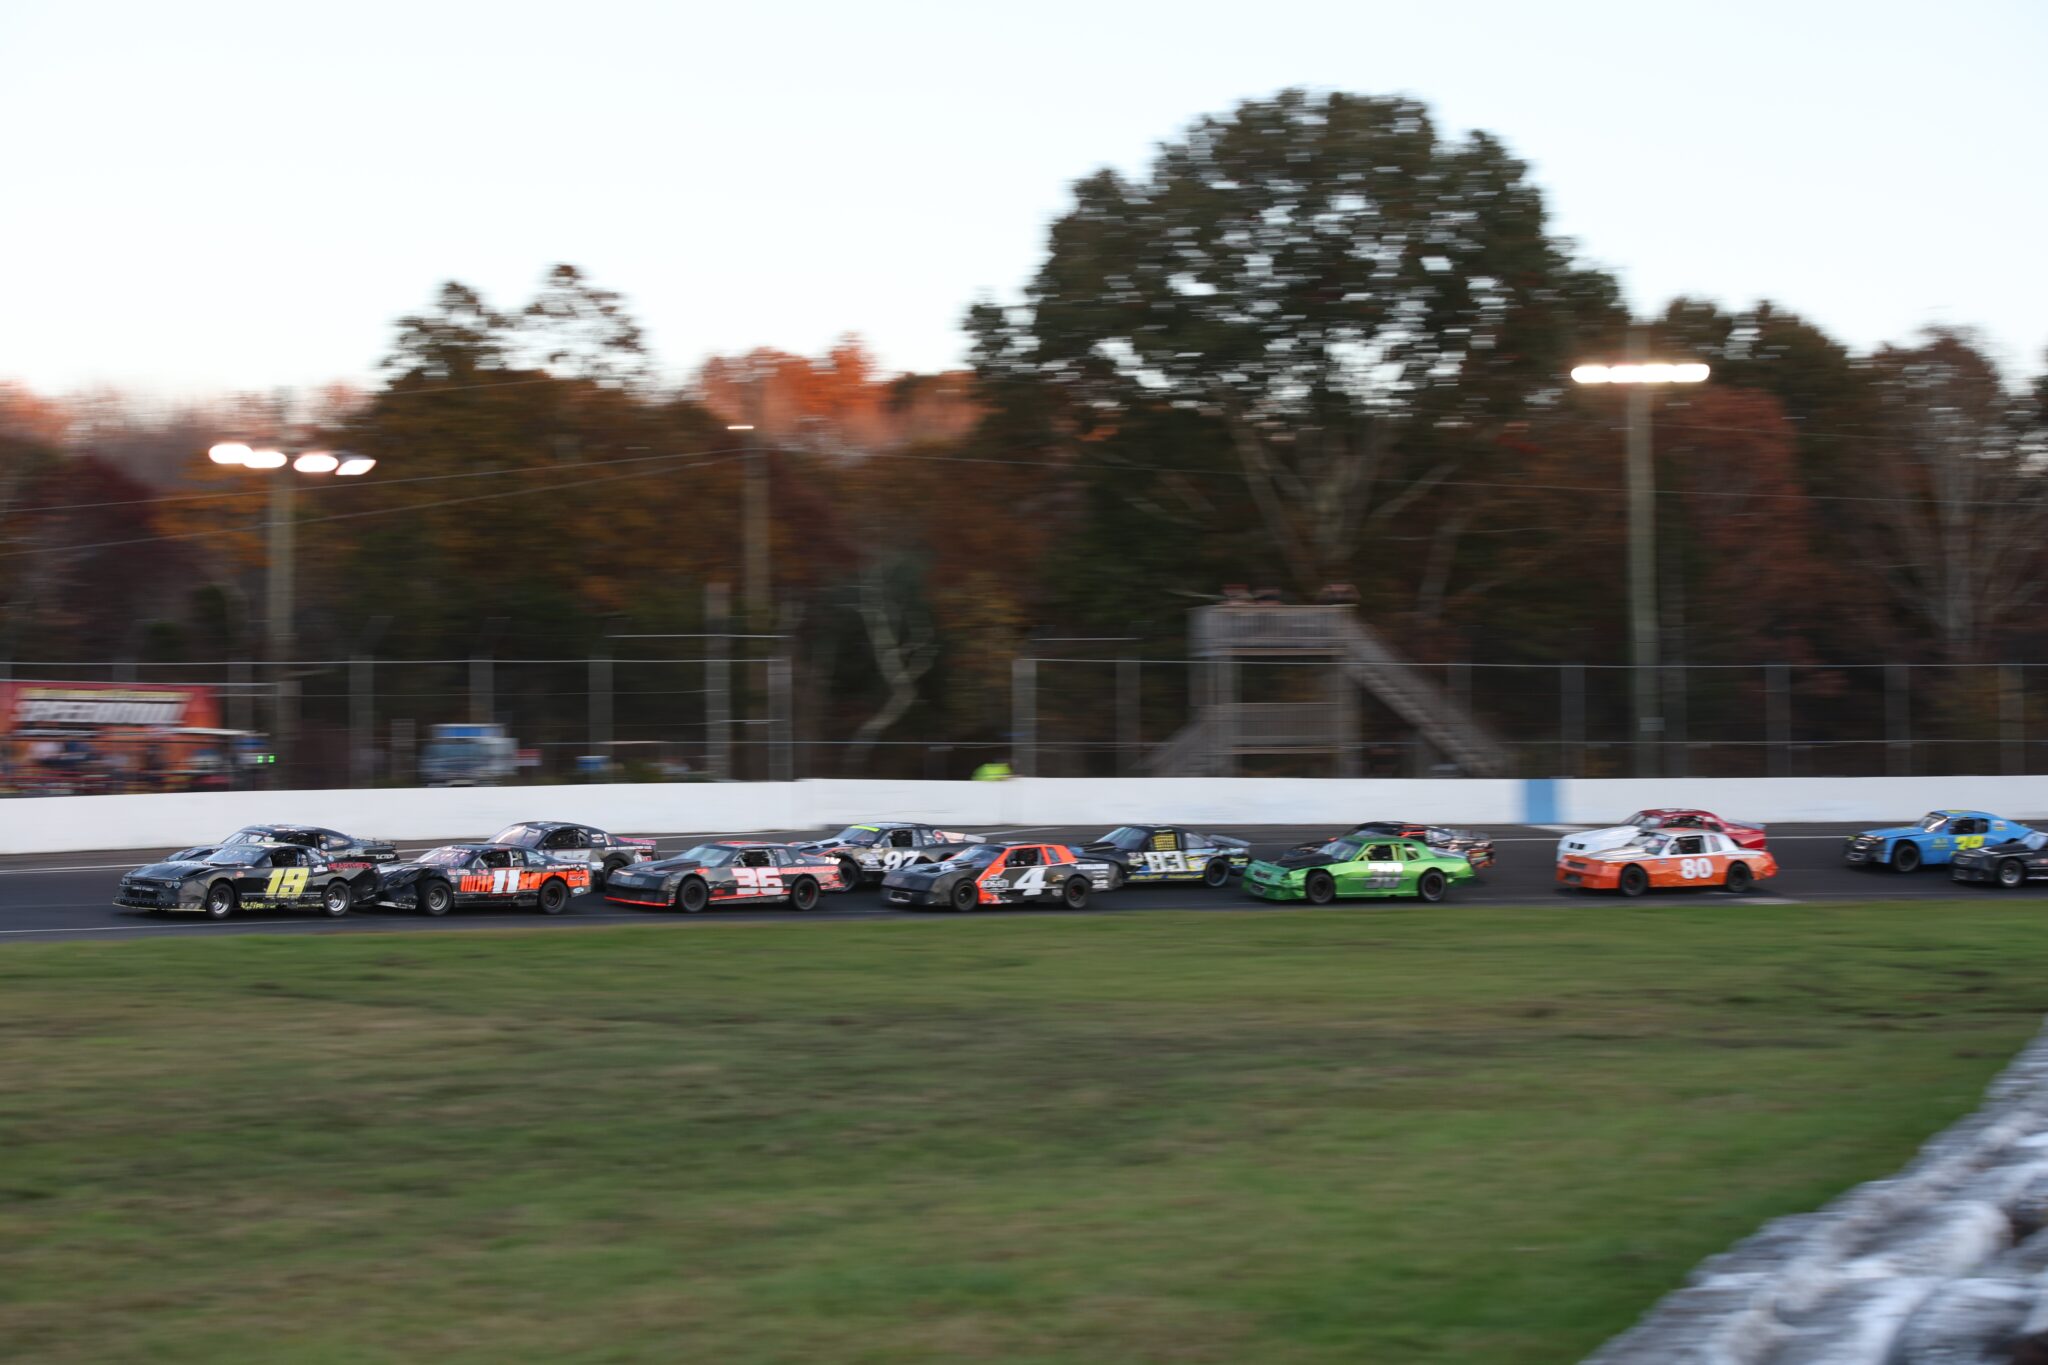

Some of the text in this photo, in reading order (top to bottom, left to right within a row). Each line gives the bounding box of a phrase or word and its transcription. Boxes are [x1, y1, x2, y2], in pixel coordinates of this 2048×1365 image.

[883, 850, 920, 872] 97
[1680, 857, 1713, 879] 80
[265, 867, 310, 898] 19
[492, 868, 521, 894] 11
[731, 866, 784, 895] 36
[1013, 866, 1048, 896] 4
